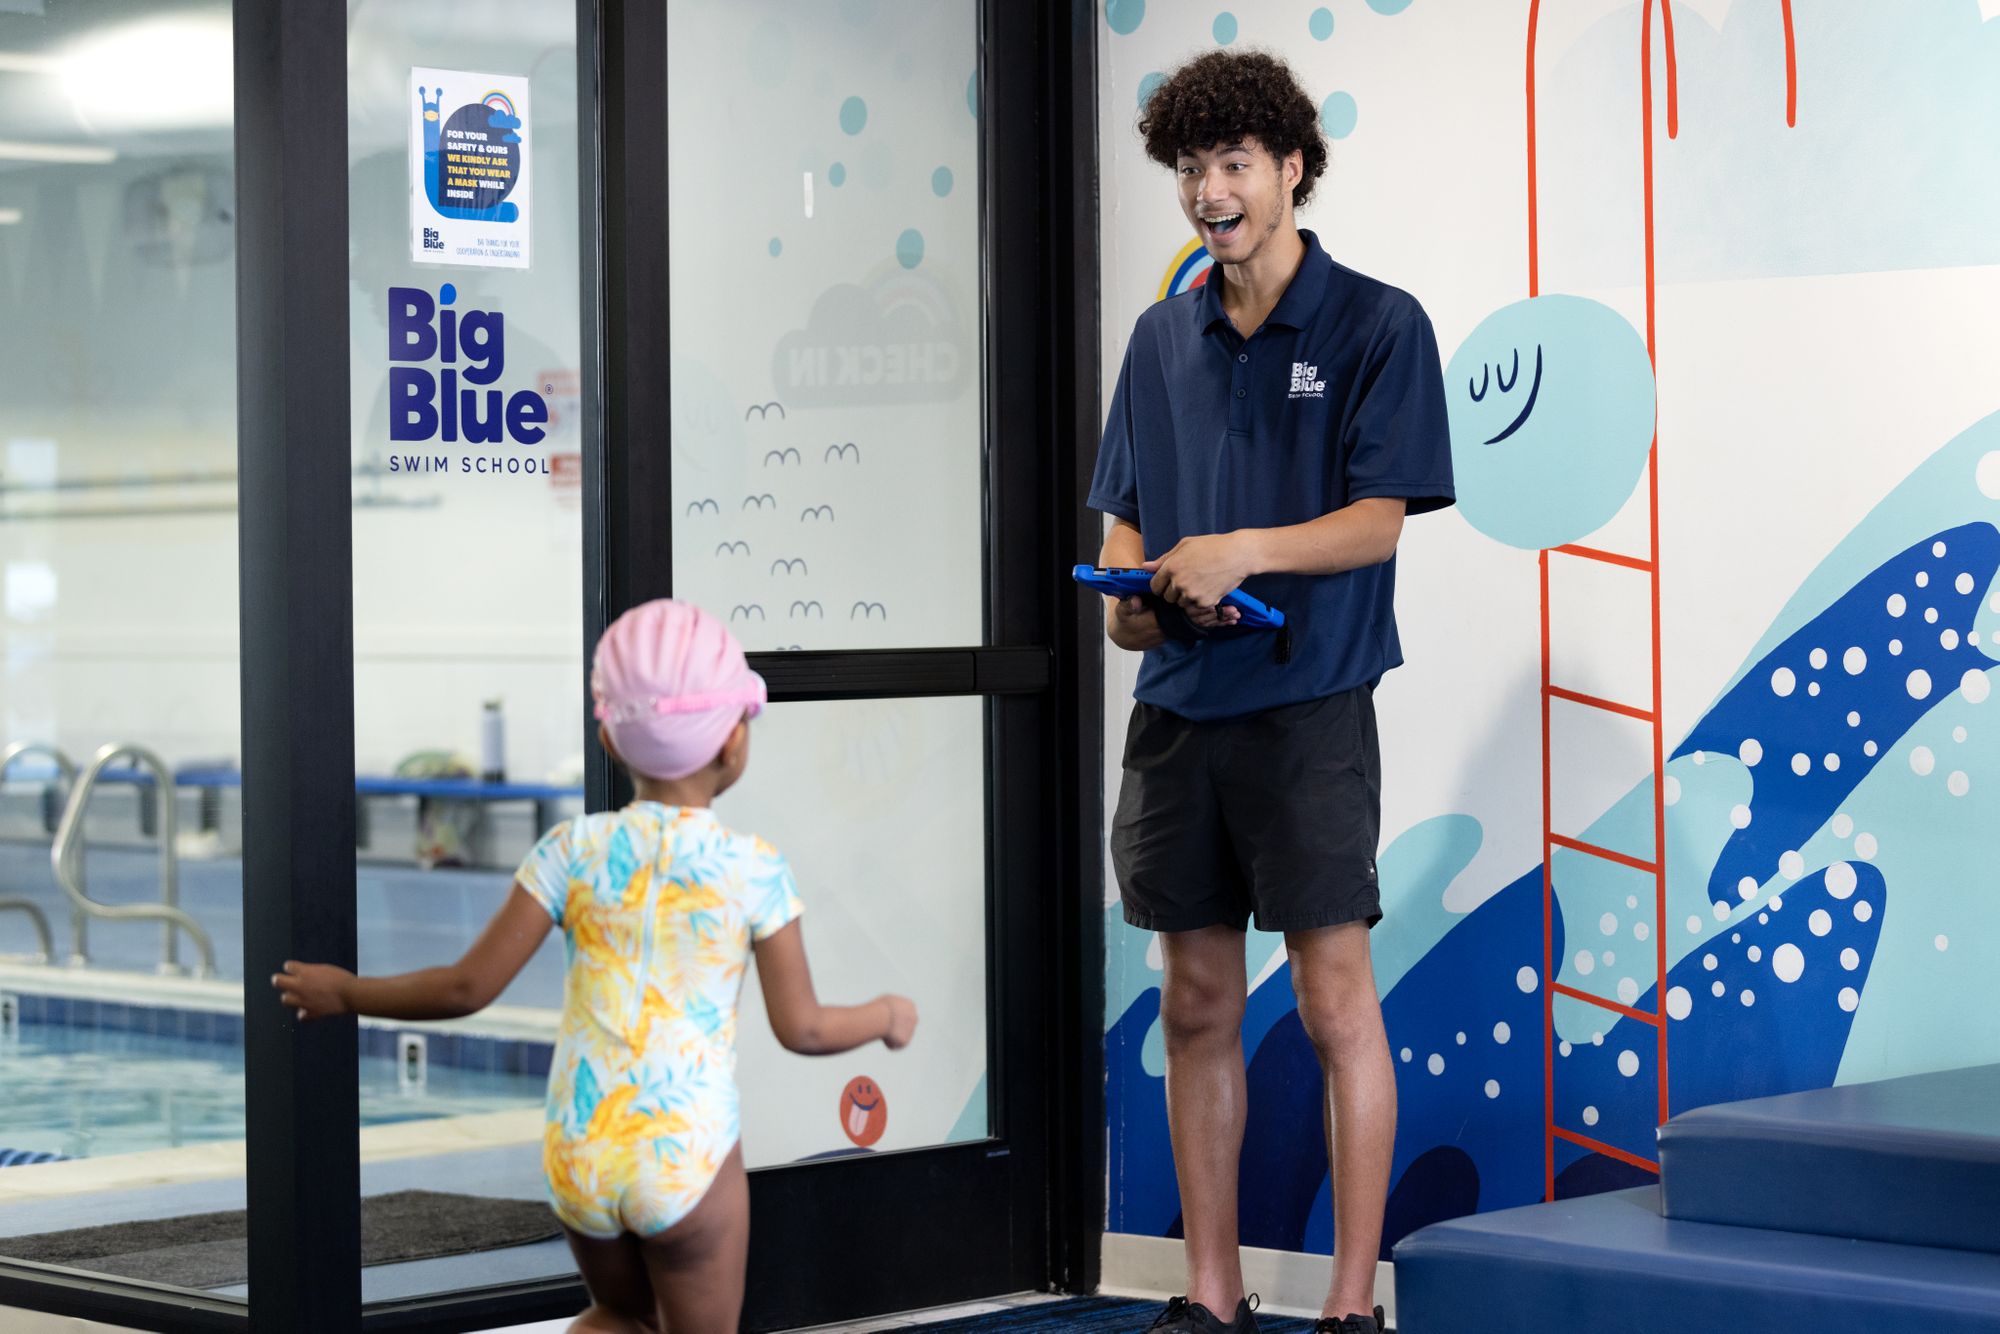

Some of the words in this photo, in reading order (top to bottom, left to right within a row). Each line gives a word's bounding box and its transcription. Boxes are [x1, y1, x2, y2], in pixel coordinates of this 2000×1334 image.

[447, 130, 464, 139] FOR
[465, 131, 488, 141] YOUR
[447, 142, 477, 152] SAFETY
[478, 144, 485, 153] &
[486, 145, 508, 154] OURS
[447, 153, 461, 162] WE
[462, 155, 491, 165] KINDLY
[492, 157, 508, 166] ASK
[447, 165, 468, 174] THAT
[469, 167, 486, 176] YOU
[487, 168, 511, 178] WEAR
[447, 177, 454, 186] A
[455, 178, 478, 188] MASK
[479, 179, 505, 190] WHILE
[447, 189, 474, 199] INSIDE
[423, 228, 439, 240] Big
[423, 239, 445, 249] Blue
[388, 283, 504, 385] Big
[1291, 361, 1318, 381] Big
[1289, 377, 1326, 392] Blue
[390, 455, 448, 472] SWIM
[462, 457, 549, 474] SCHOOL
